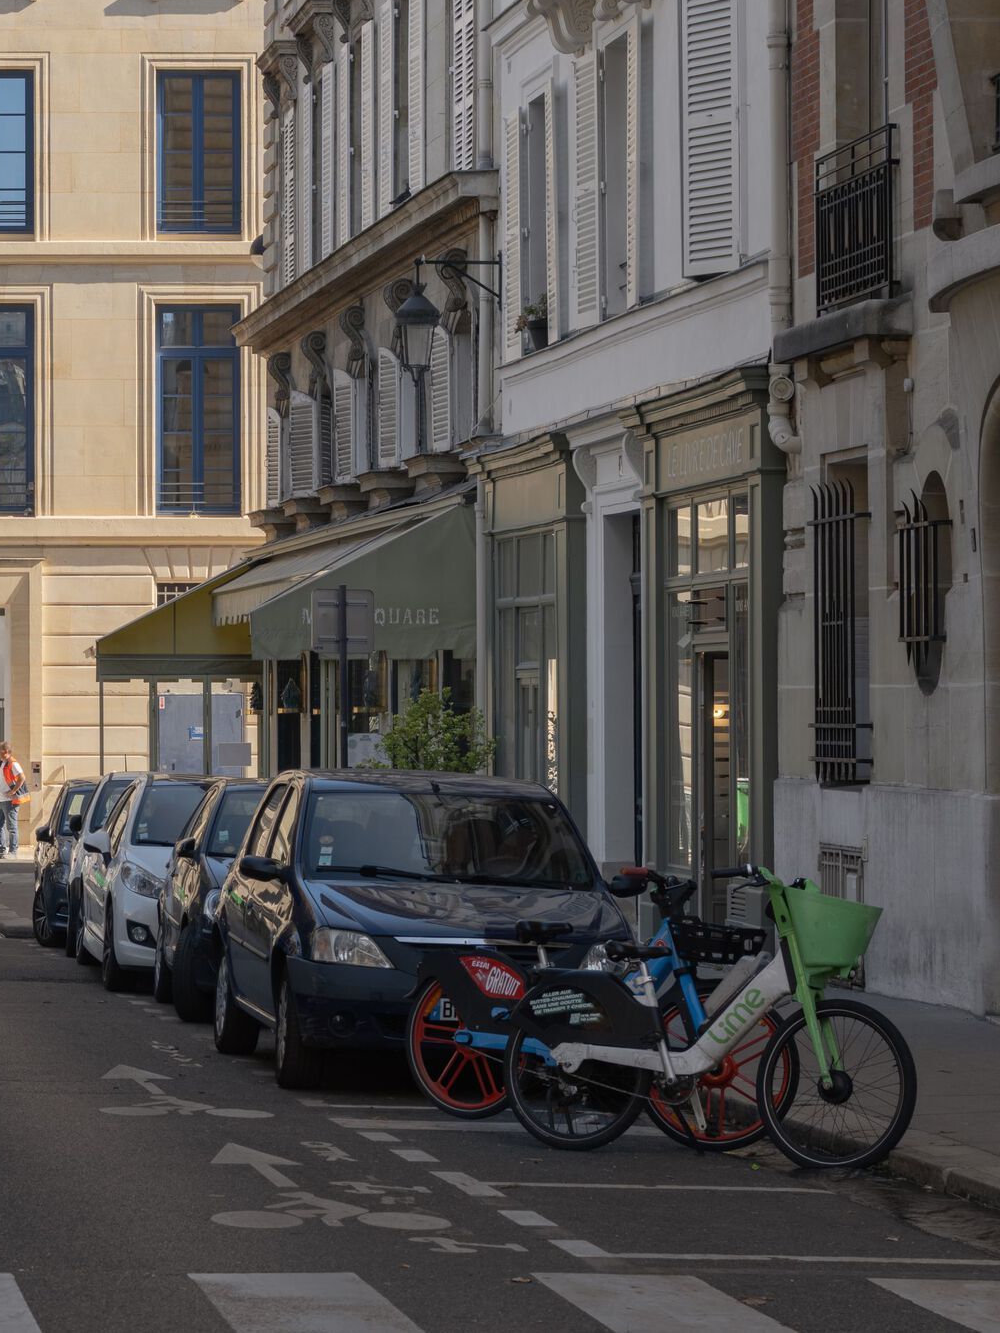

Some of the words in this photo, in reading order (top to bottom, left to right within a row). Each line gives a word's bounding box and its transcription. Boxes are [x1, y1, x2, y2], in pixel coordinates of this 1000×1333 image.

[374, 608, 440, 626] QUARE
[471, 960, 490, 970] ESSAI
[485, 966, 521, 997] GRATUIT
